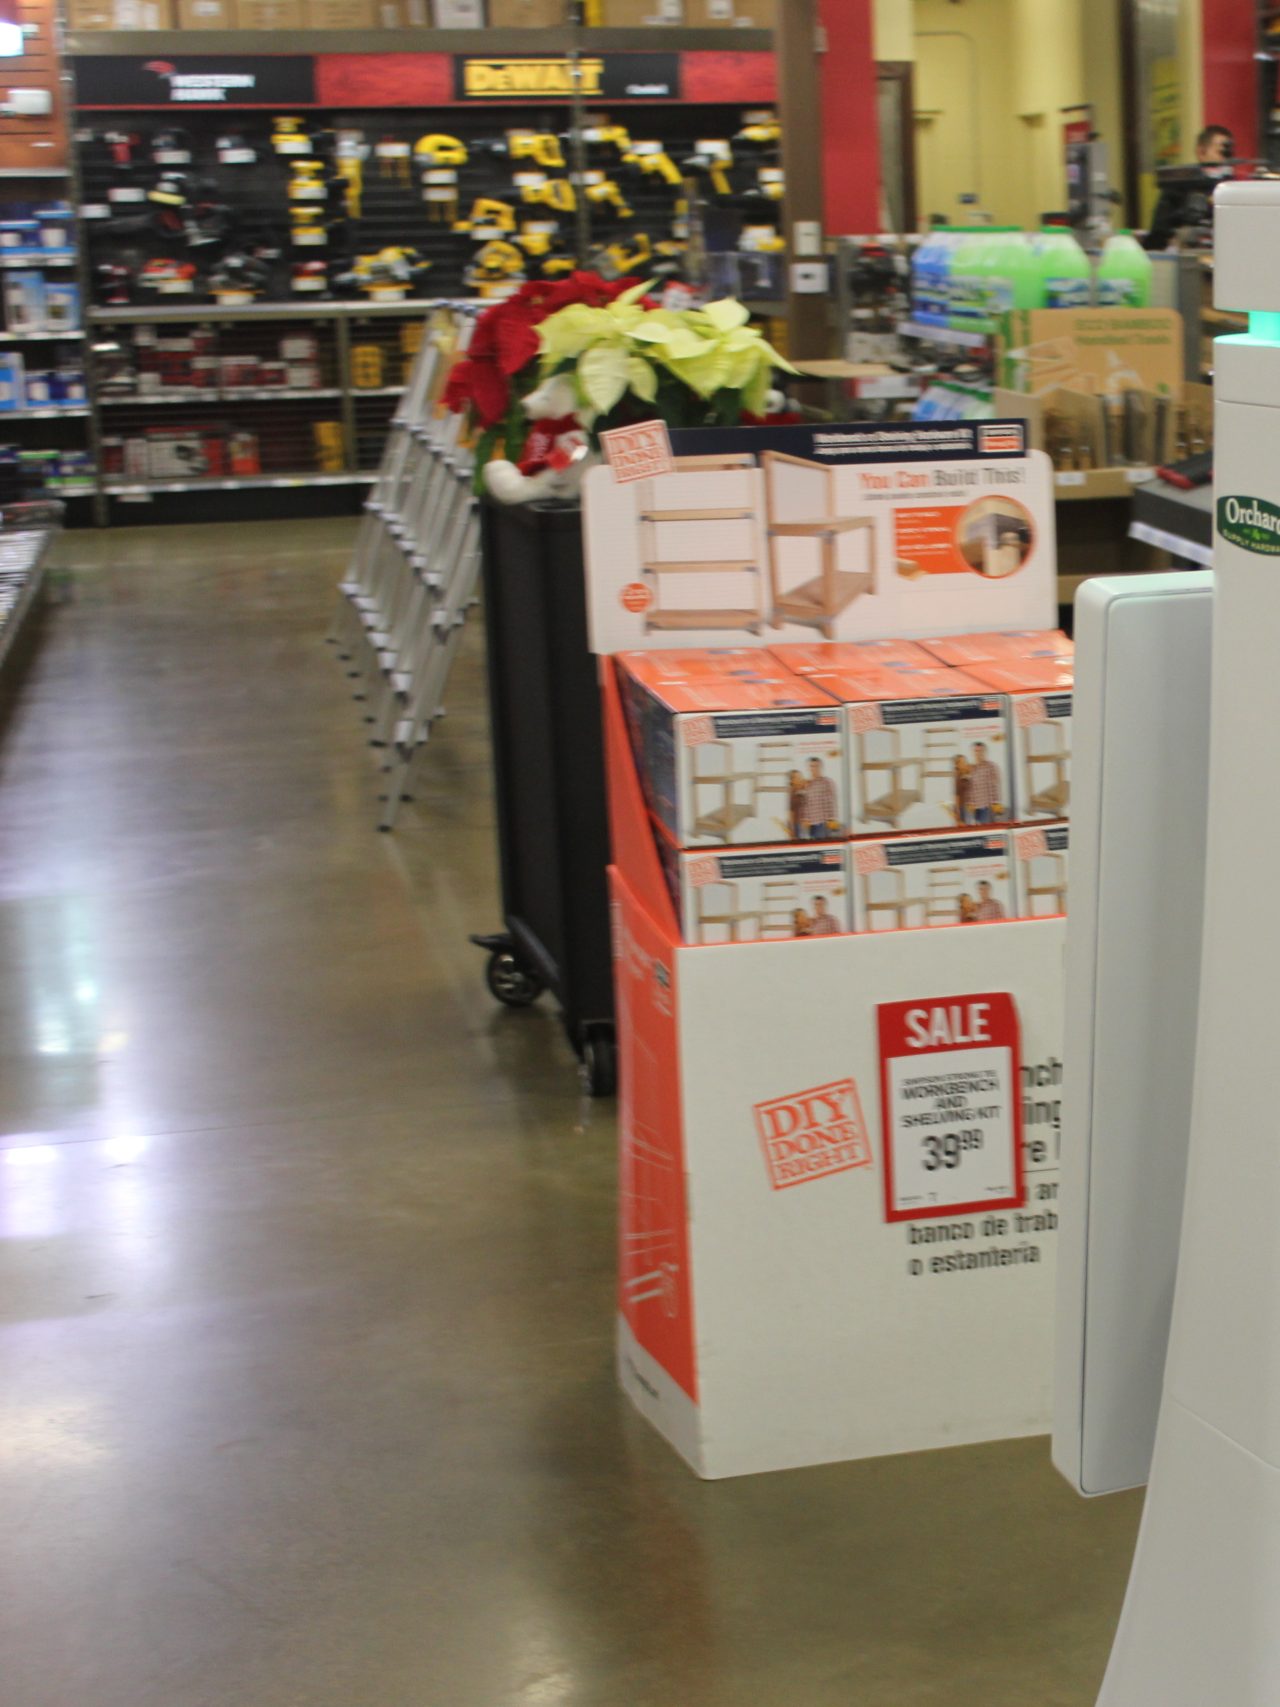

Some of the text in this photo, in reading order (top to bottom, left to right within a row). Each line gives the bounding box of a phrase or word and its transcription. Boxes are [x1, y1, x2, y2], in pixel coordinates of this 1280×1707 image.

[858, 472, 891, 489] You
[895, 470, 930, 488] Can
[934, 468, 977, 486] Build
[904, 1002, 992, 1048] SALE
[902, 1078, 999, 1100] WORKBENCH
[762, 1087, 849, 1139] DIY
[901, 1109, 976, 1128] SHELVING
[769, 1121, 859, 1161] DONE
[908, 1223, 975, 1245] banco
[981, 1215, 1009, 1237] de
[908, 1258, 924, 1276] o
